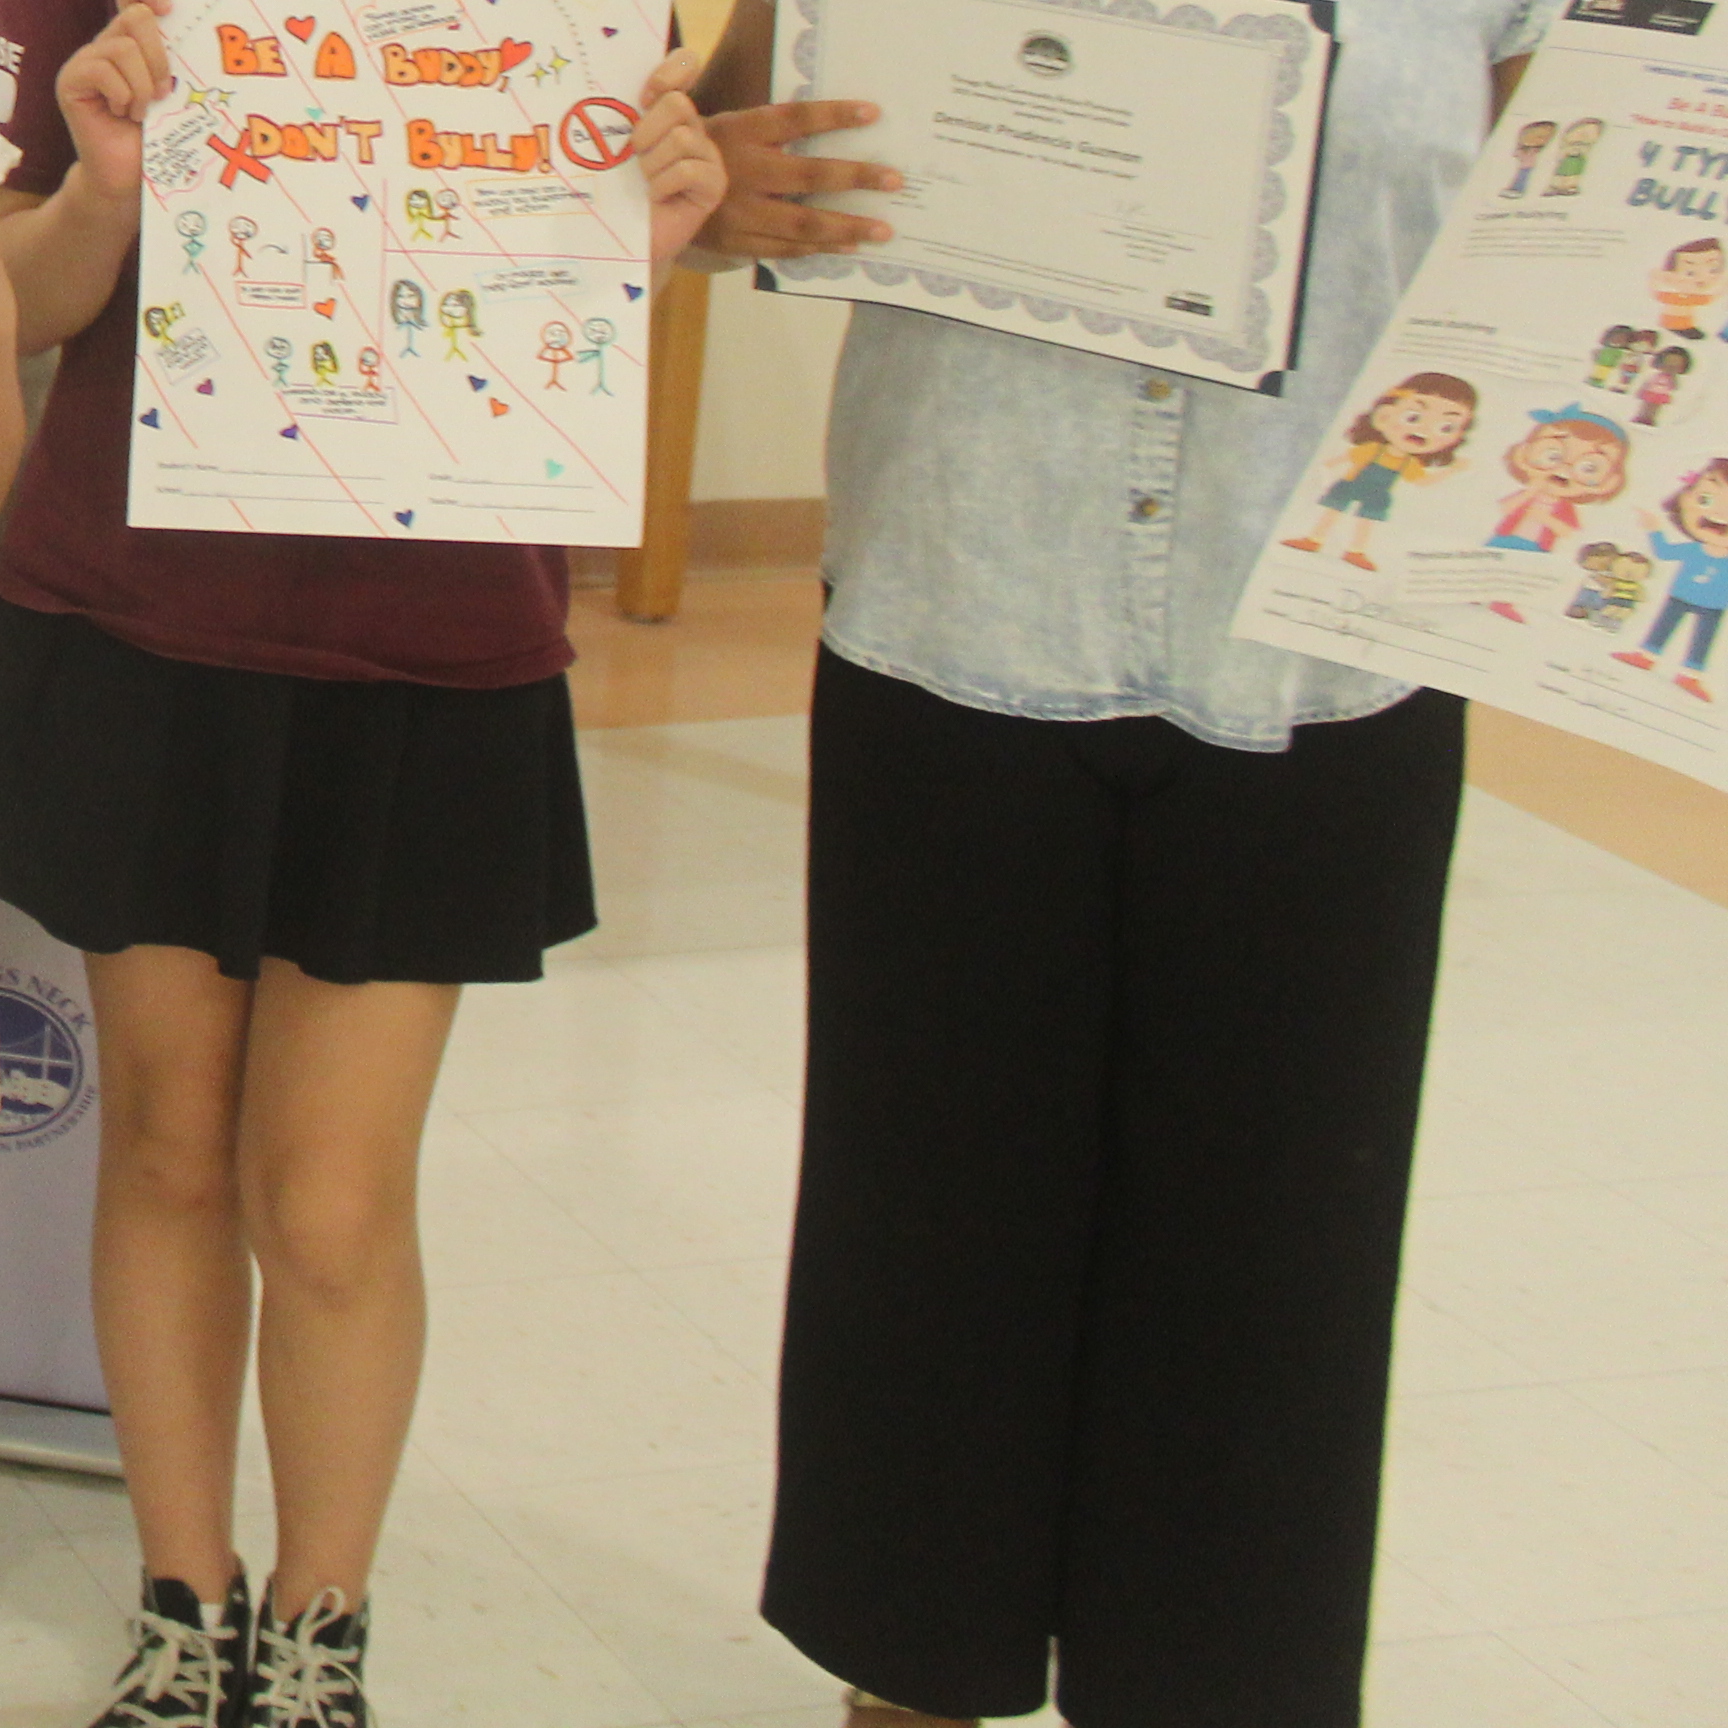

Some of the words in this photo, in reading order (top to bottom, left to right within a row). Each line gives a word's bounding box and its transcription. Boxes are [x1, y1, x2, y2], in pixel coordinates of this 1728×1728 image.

[215, 24, 288, 78] BE
[313, 32, 356, 79] A
[246, 113, 382, 164] DON'T
[407, 116, 551, 173] BULLY!
[31, 976, 91, 1032] NECK
